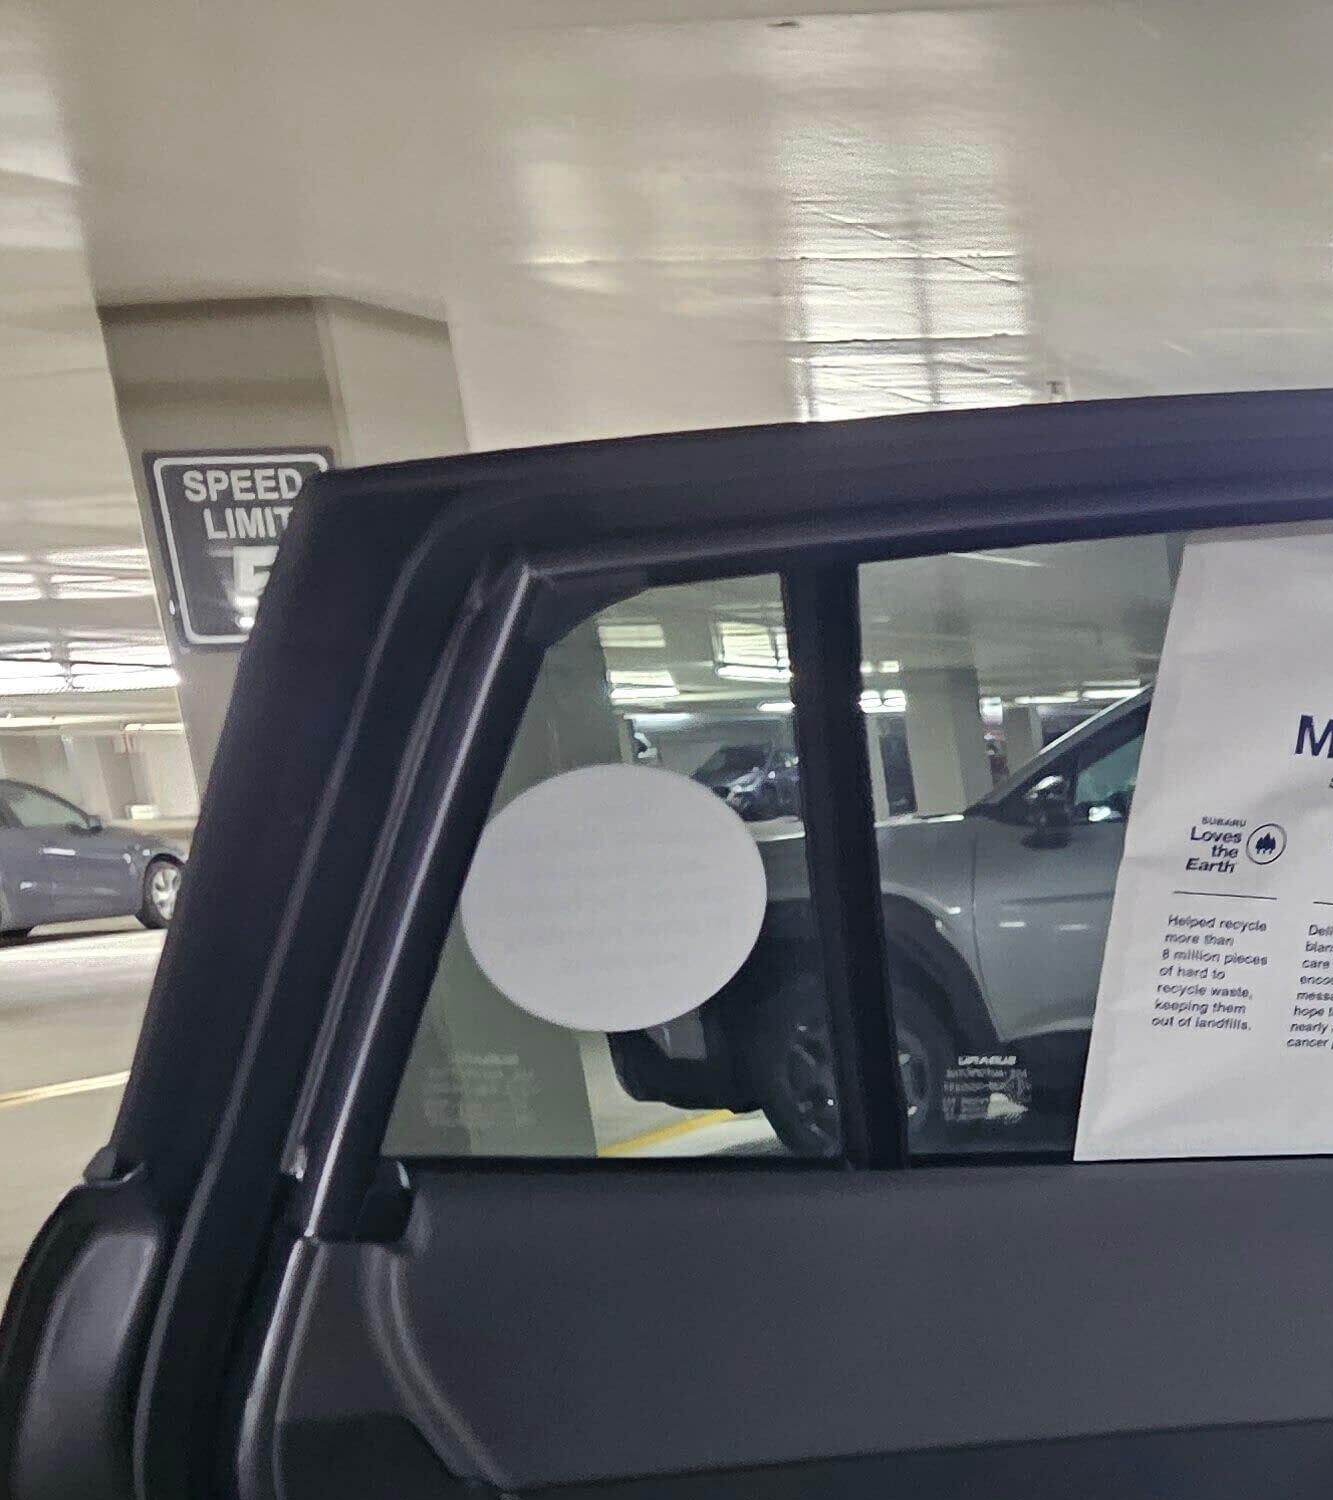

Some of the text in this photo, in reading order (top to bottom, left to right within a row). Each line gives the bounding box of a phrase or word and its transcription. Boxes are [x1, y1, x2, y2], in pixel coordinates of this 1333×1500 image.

[183, 468, 302, 502] SPEED
[203, 506, 294, 540] LIMIT
[1202, 816, 1247, 828] SUBARU
[1191, 826, 1242, 843] Loves
[1211, 844, 1239, 858] the
[1186, 857, 1235, 873] Earth
[1168, 914, 1267, 932] Helped recycle
[1164, 933, 1234, 946] more than
[1162, 948, 1268, 965] 8 million pieces
[1302, 959, 1330, 970] care
[1159, 965, 1226, 980] of hard to
[1157, 983, 1207, 997] recycle
[1155, 999, 1247, 1015] keeping them
[1293, 1005, 1325, 1020] hope
[1151, 1016, 1252, 1031] out of landfills.
[1289, 1022, 1328, 1035] nearly
[1286, 1038, 1329, 1049] cancer
